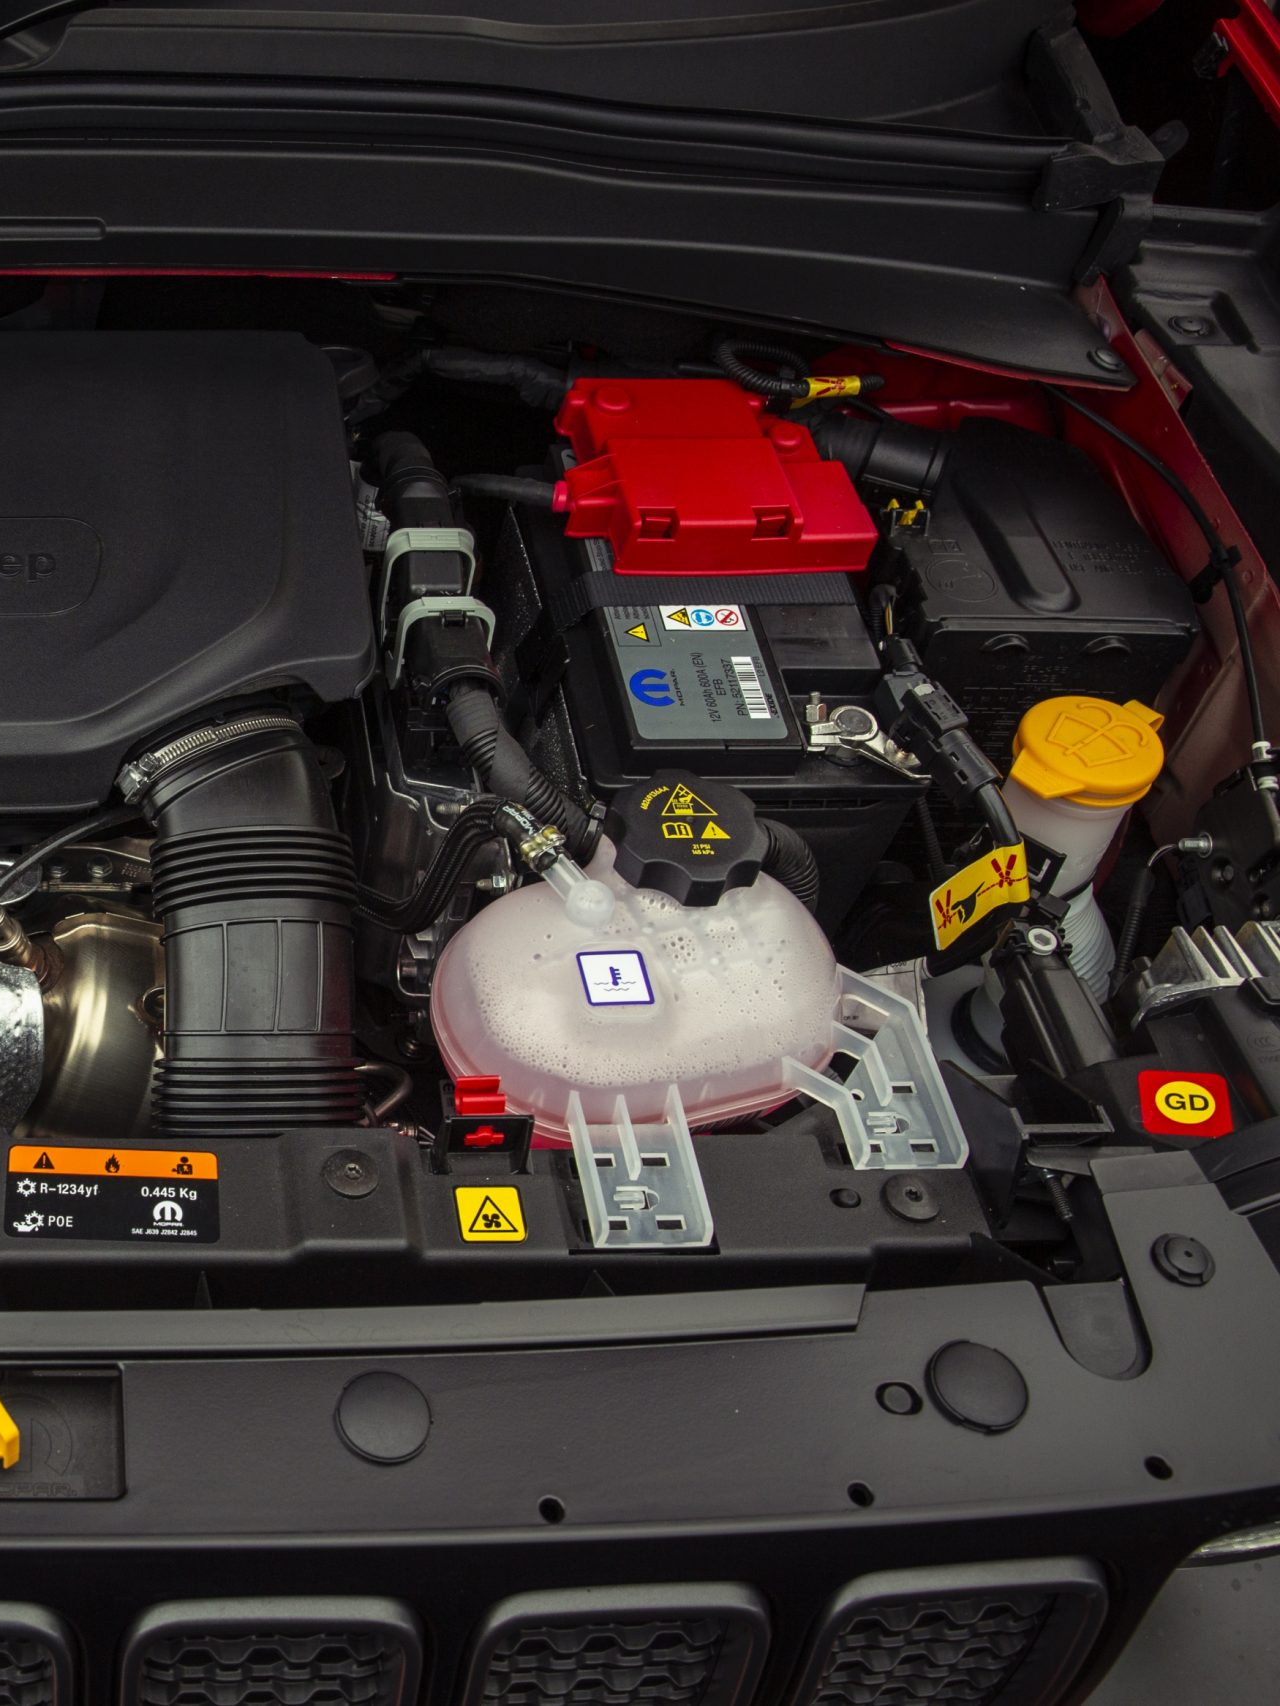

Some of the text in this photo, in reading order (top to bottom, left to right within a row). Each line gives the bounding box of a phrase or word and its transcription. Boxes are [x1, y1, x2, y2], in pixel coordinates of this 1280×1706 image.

[670, 669, 685, 706] MOPAR
[690, 652, 723, 723] 12V 60Ah 600A (EN)
[713, 678, 727, 696] EFB
[721, 658, 749, 716] PN: 52117337
[502, 805, 534, 836] MOPAR
[1165, 1092, 1209, 1111] GD
[40, 1183, 198, 1201] R-1234yf 0.445 Kg
[48, 1215, 74, 1228] POE
